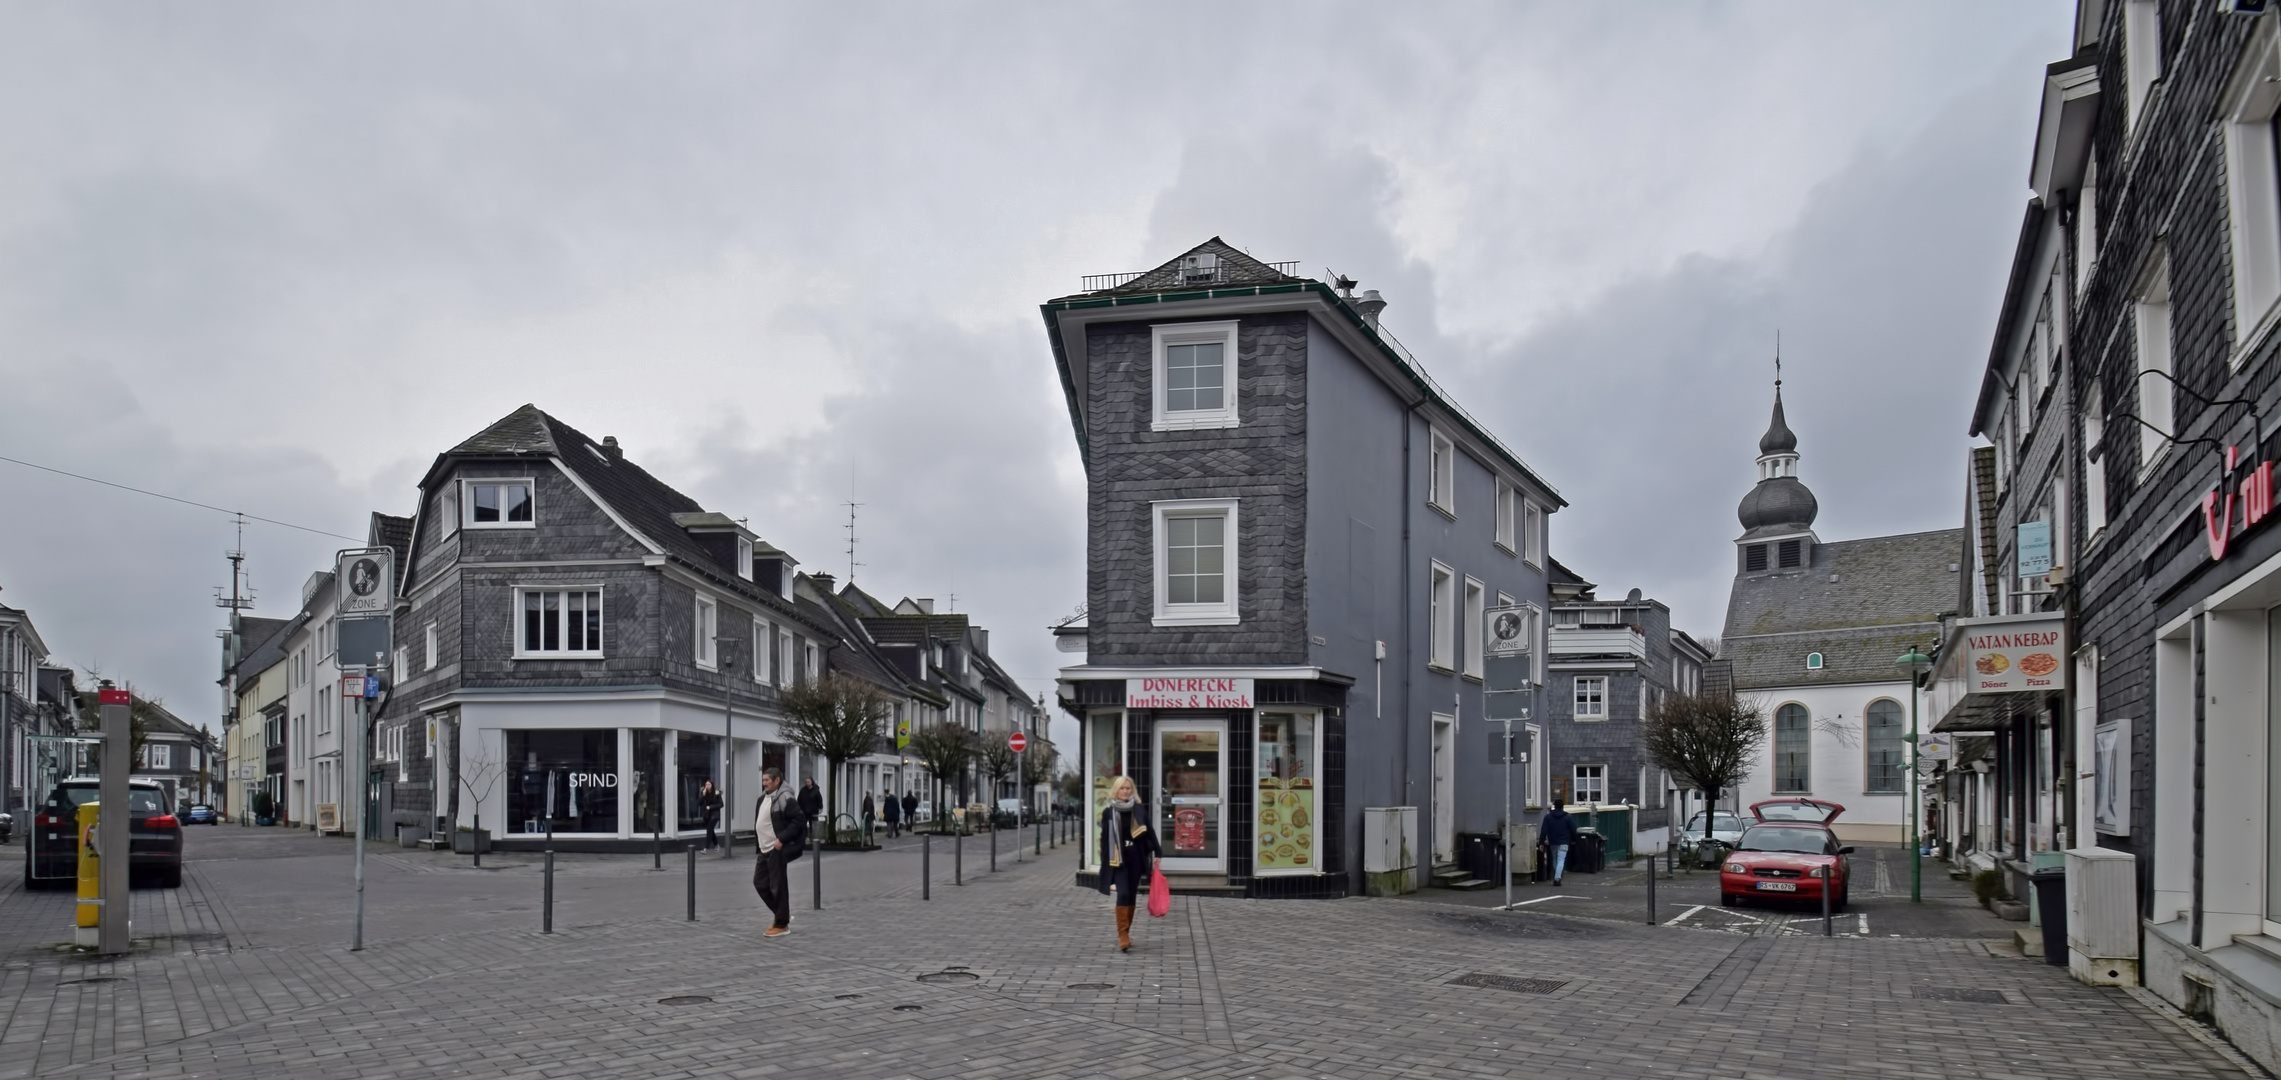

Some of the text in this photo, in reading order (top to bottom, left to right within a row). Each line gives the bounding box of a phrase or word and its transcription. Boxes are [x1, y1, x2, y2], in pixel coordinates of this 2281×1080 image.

[2240, 460, 2273, 530] TUI
[352, 599, 376, 609] ZONE
[1497, 641, 1519, 650] ZONE
[1968, 631, 2059, 650] VATAN KEBAP
[1981, 679, 2051, 689] Döner Pizza
[1130, 695, 1250, 708] Imbiss & Kiosk
[569, 772, 618, 788] SPIND
